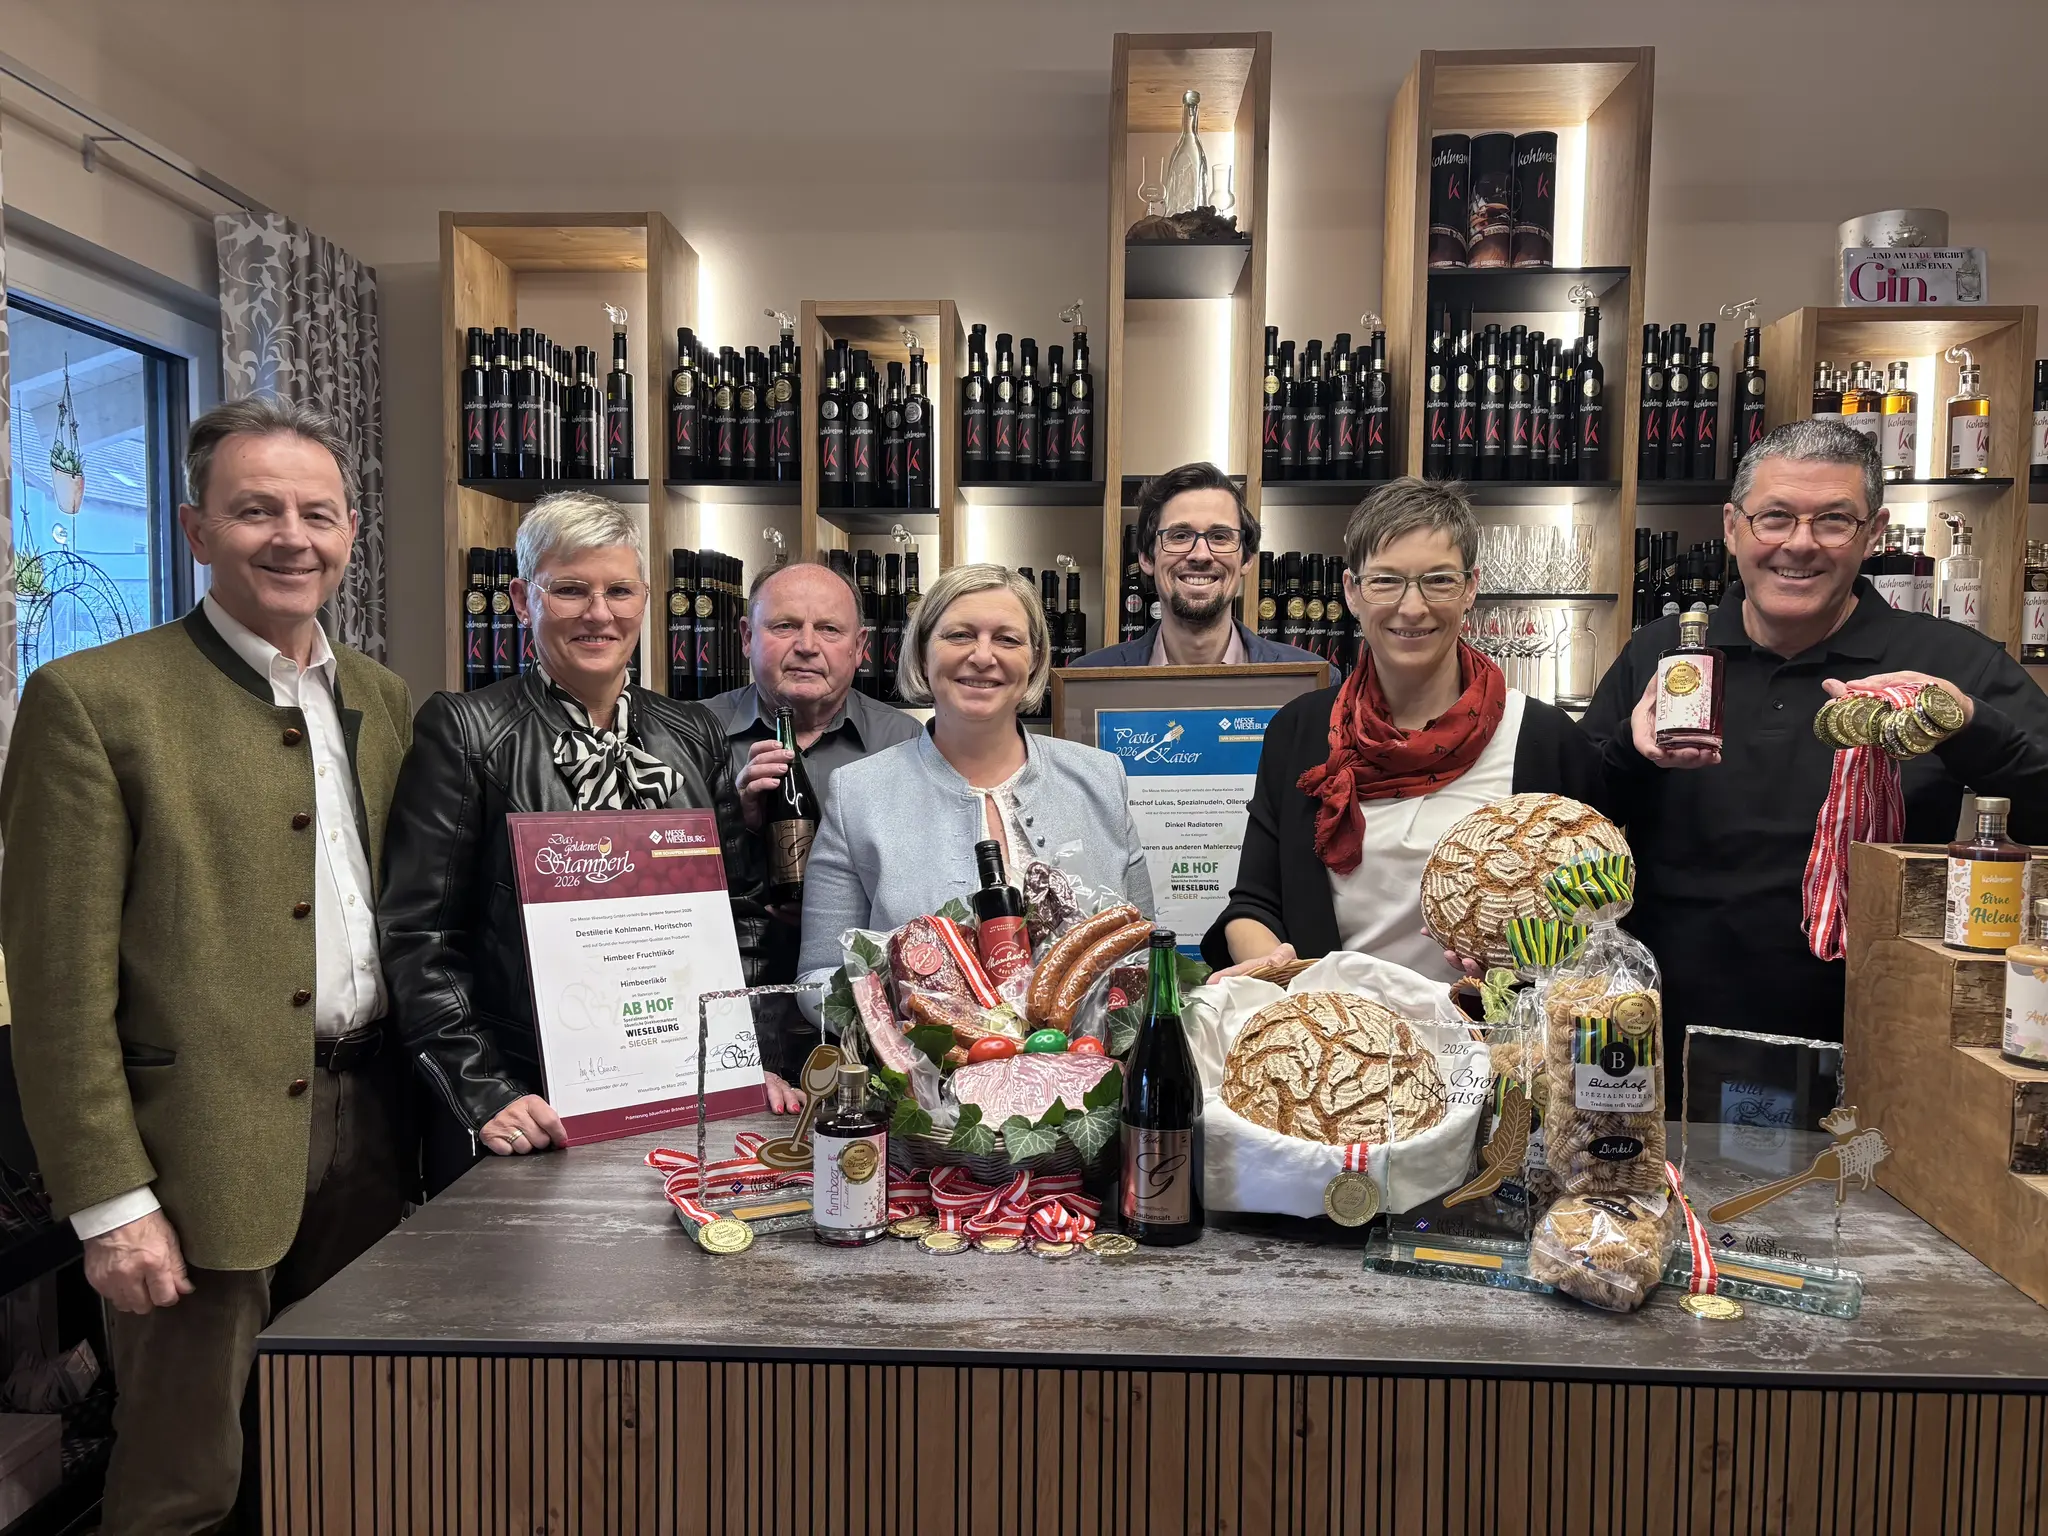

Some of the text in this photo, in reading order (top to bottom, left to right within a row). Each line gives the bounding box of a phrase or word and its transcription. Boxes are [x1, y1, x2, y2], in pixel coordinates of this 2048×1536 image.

[1850, 262, 1937, 302] Gin.
[1921, 591, 1930, 612] k
[1964, 593, 1975, 615] k
[2035, 607, 2044, 628] k
[1113, 727, 1157, 744] Pasta
[1115, 746, 1138, 757] 2026
[1144, 747, 1202, 763] Kaiser
[548, 833, 574, 845] Das
[665, 829, 685, 837] MESSE
[665, 834, 706, 844] WIESELBURG
[564, 841, 598, 857] goldene
[535, 846, 635, 881] Stamperl
[1171, 862, 1218, 873] AB HOF
[555, 876, 580, 888] 2026
[1980, 892, 2010, 905] Birne
[1970, 907, 2019, 924] Helene
[576, 921, 692, 937] Destillerie Kohlmann, Horitschon
[603, 949, 675, 962] Himbeer Fruchtlikör
[620, 977, 667, 987] Himbeerlikör
[623, 997, 673, 1016] AB HOF
[626, 1023, 679, 1037] WIESELBURG
[629, 1038, 658, 1048] SIEGER
[1442, 1044, 1471, 1055] 2026
[1612, 1052, 1625, 1069] B
[1450, 1066, 1498, 1090] Brot
[1588, 1077, 1647, 1092] Bischof
[1411, 1083, 1493, 1105] Kaiser
[1599, 1142, 1634, 1156] Dinkel
[1130, 1152, 1187, 1200] G
[1745, 1236, 1778, 1248] MESSE
[1746, 1244, 1808, 1263] WIESELBURG
